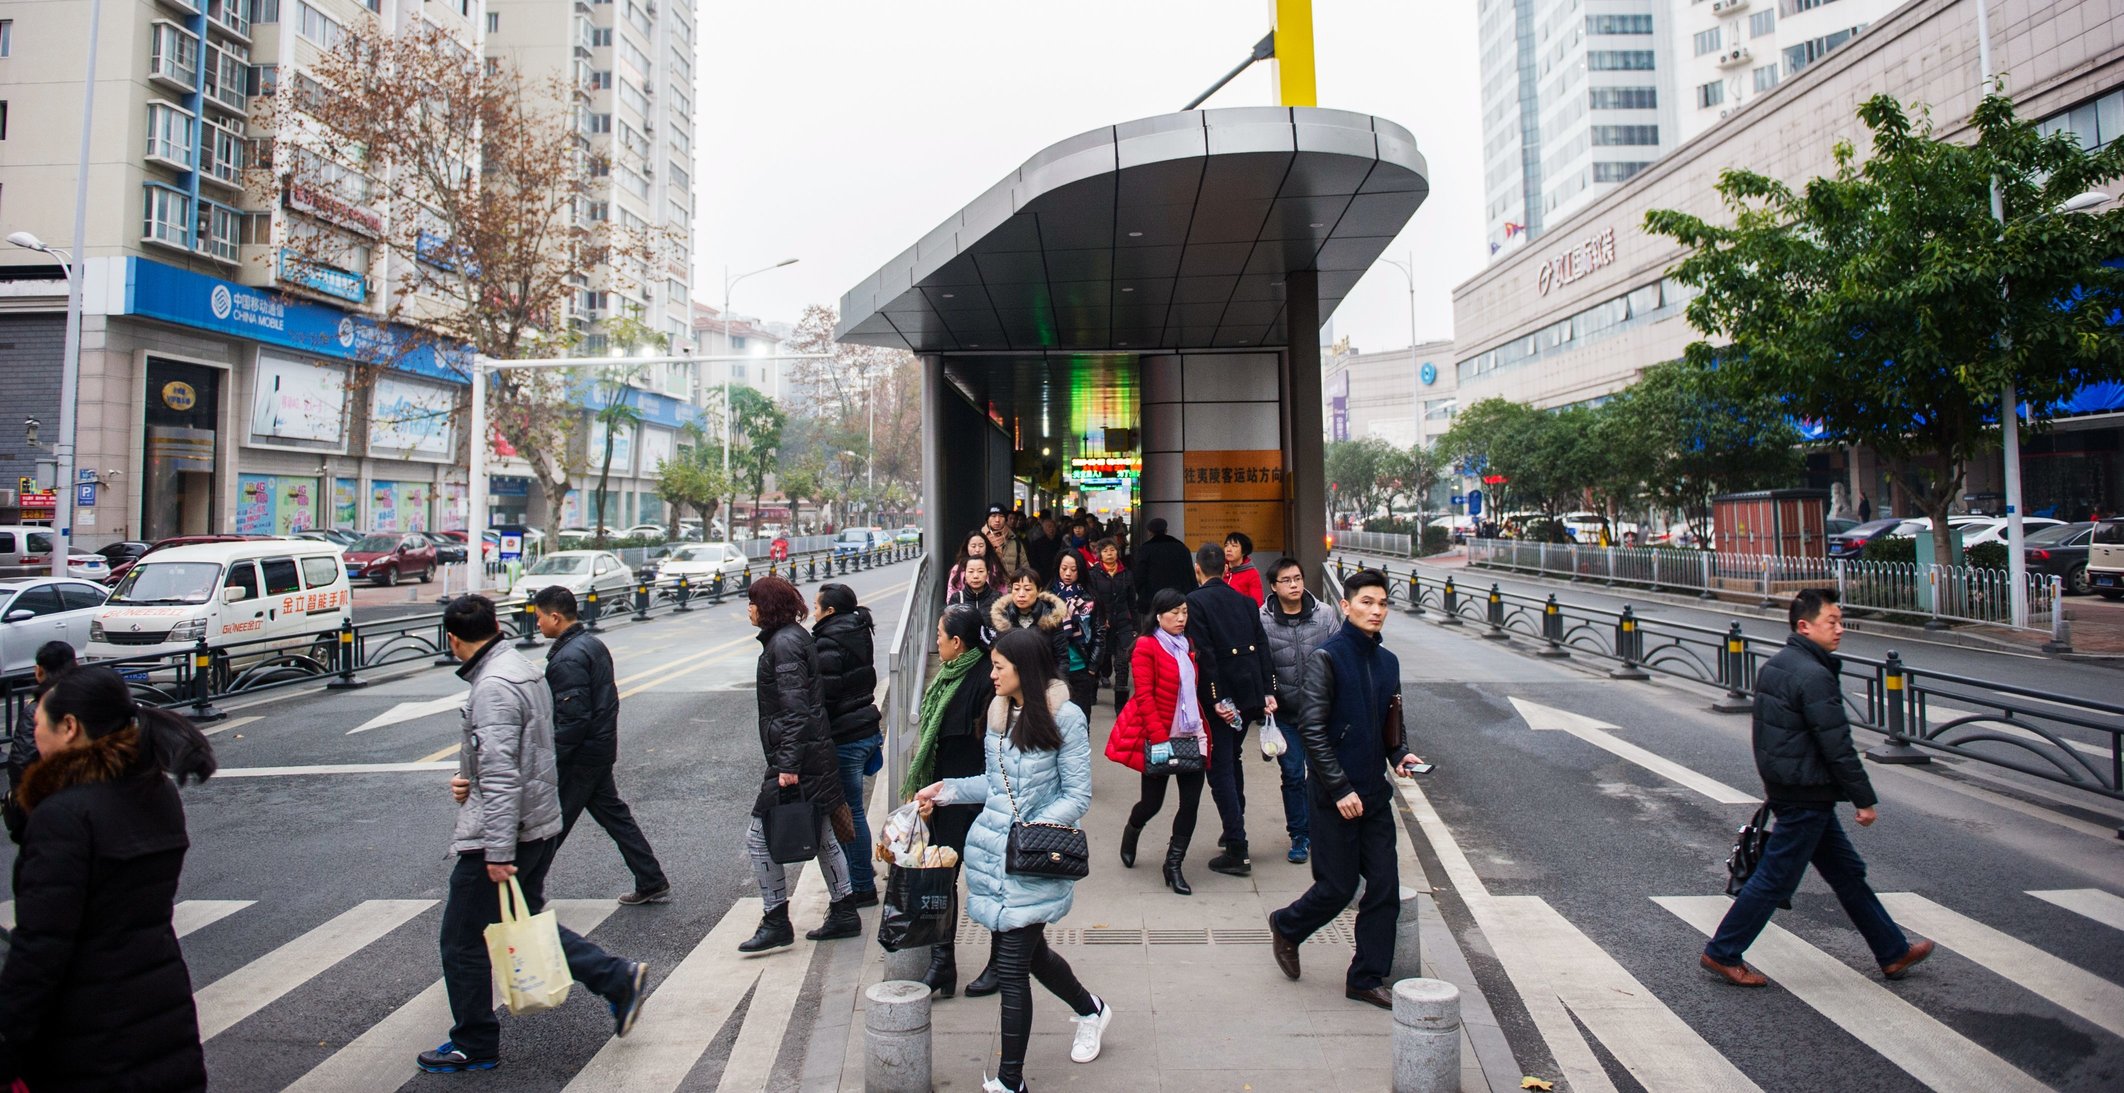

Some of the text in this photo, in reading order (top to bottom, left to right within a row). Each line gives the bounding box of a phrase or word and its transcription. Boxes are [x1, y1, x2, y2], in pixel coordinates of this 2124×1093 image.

[233, 291, 285, 318] 中国移动通信
[233, 309, 285, 331] CHINA MOBILE
[1184, 466, 1283, 484] 往夷陵客运站方向
[82, 486, 92, 497] P
[282, 589, 348, 615] 金立智能手机
